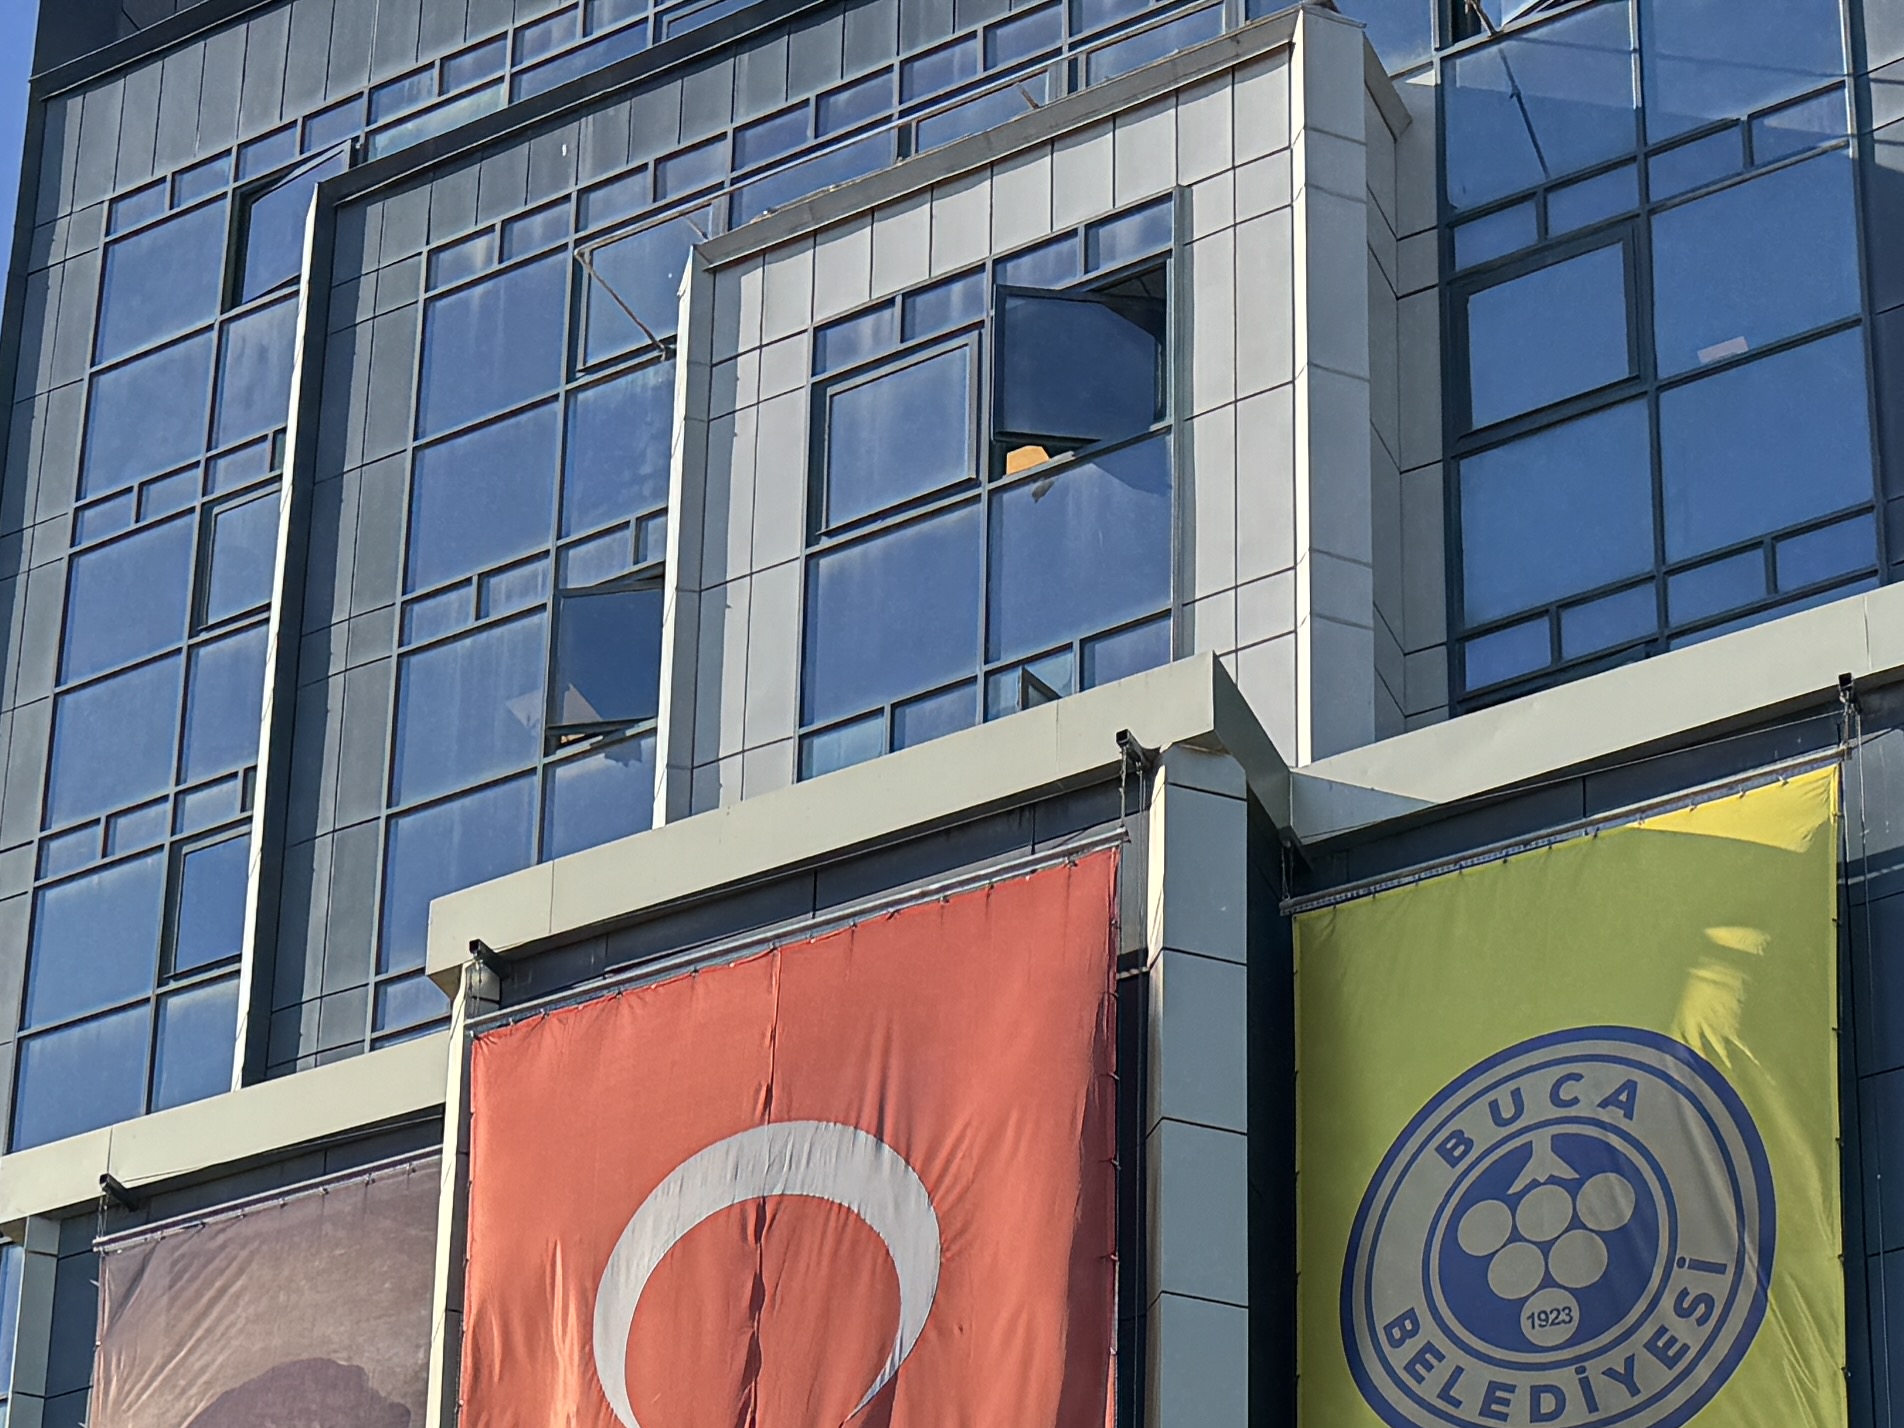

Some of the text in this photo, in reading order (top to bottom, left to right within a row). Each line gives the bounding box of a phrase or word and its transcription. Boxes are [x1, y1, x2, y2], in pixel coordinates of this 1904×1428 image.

[1436, 1071, 1639, 1168] BUCA
[1383, 1254, 1729, 1425] BELEDİYESİ
[1526, 1303, 1575, 1332] 1923
